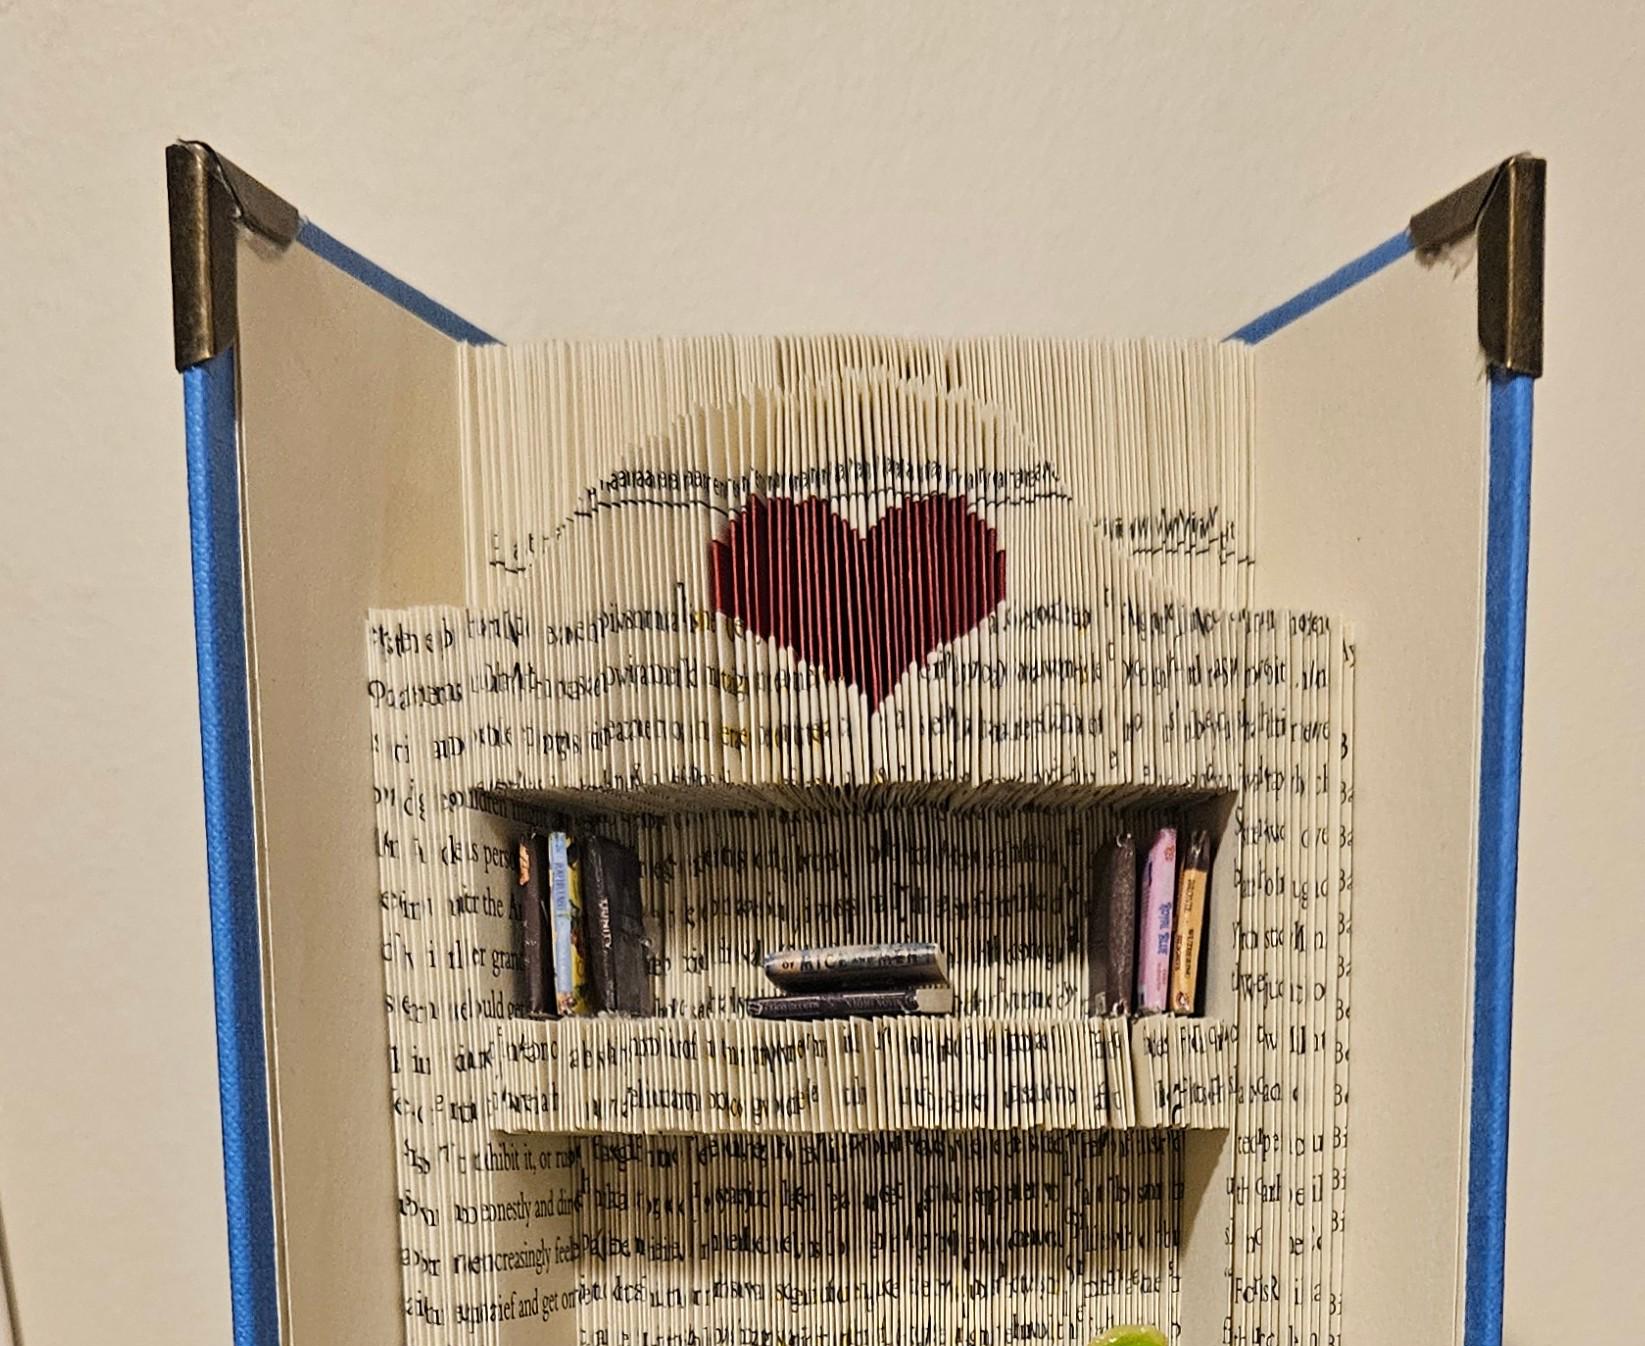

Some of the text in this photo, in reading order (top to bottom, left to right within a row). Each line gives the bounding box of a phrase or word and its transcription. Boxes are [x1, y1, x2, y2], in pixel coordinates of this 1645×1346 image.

[483, 886, 504, 919] the
[523, 1143, 537, 1175] it,
[540, 1151, 552, 1170] or
[534, 1189, 554, 1219] and
[518, 1287, 539, 1319] and
[542, 1291, 559, 1323] get
